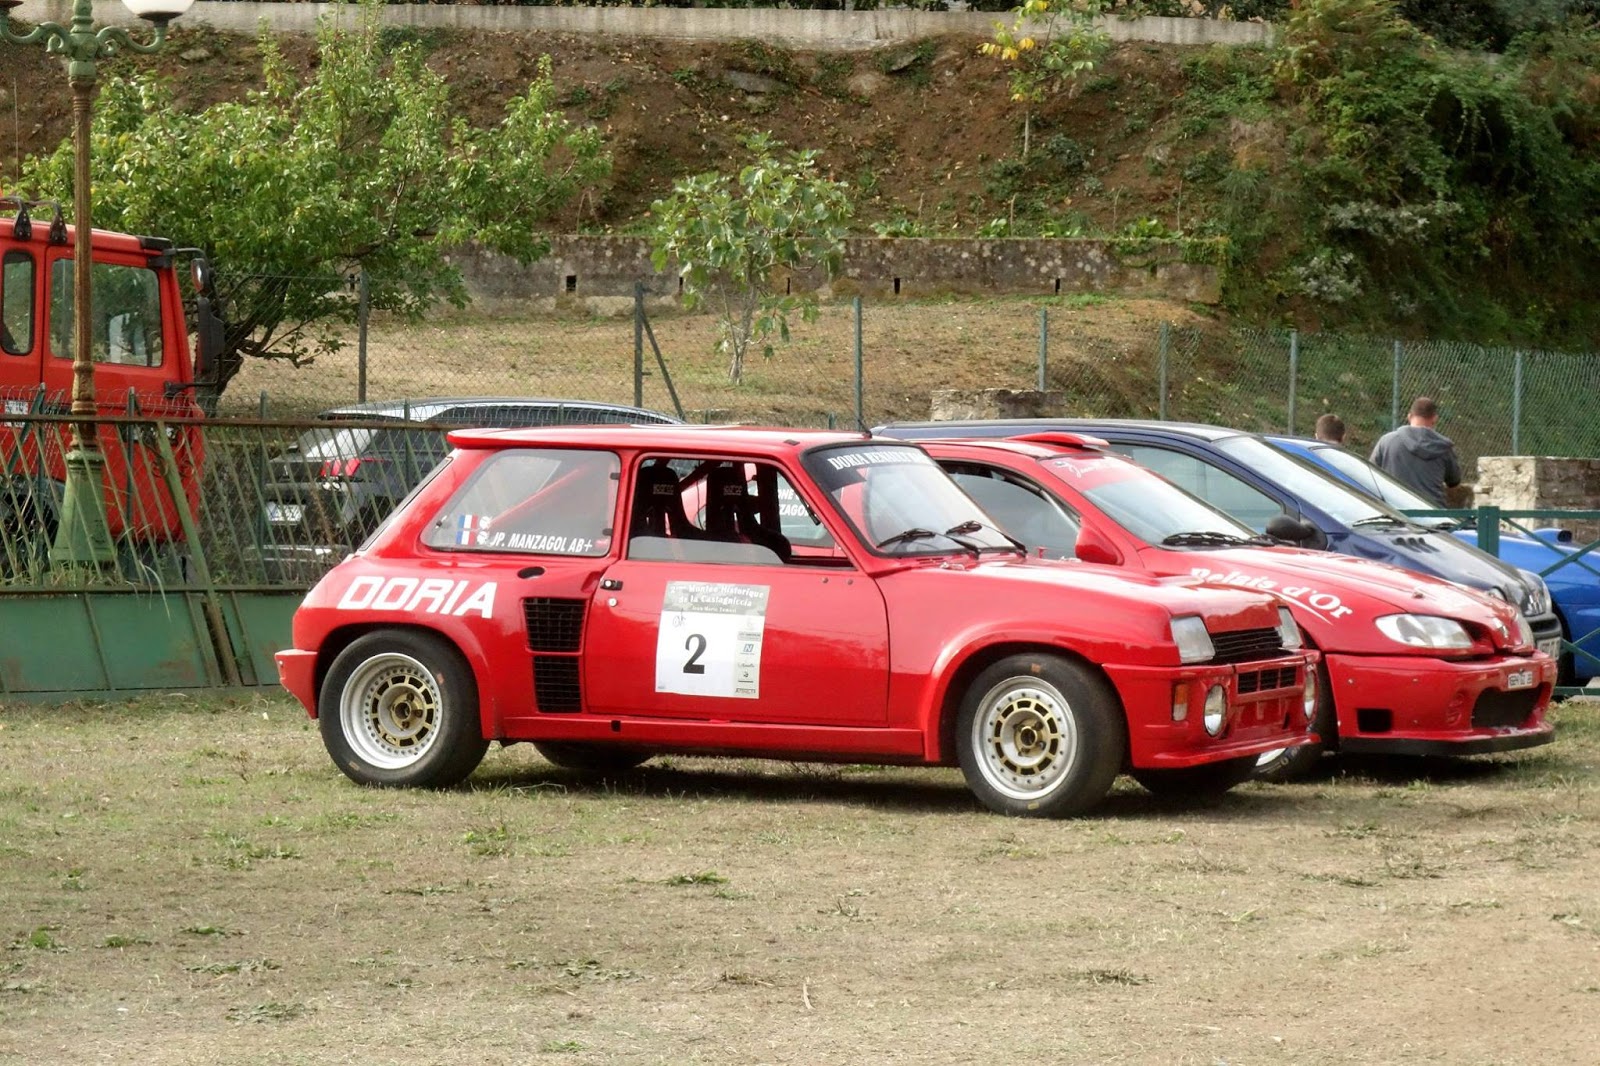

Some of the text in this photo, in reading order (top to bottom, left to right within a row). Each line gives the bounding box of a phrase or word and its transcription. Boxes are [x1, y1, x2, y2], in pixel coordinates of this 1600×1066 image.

[828, 453, 869, 470] DORIA
[489, 532, 593, 553] JP. MANZAGOL AB+
[336, 575, 497, 619] DORIA
[1281, 586, 1353, 618] d'Or
[683, 633, 707, 674] 2
